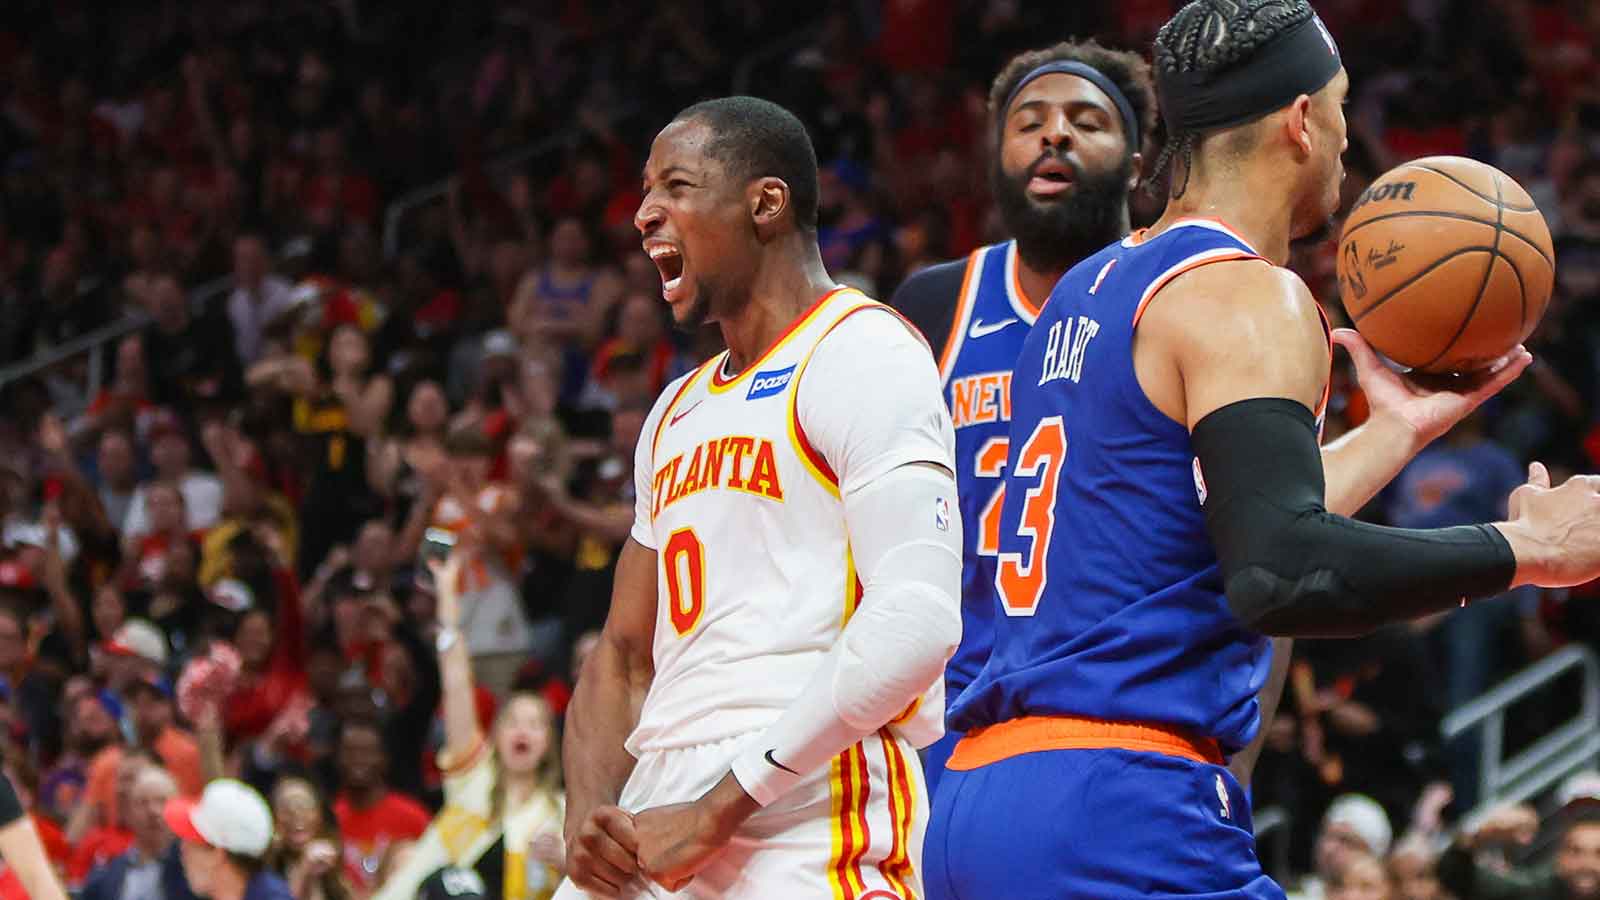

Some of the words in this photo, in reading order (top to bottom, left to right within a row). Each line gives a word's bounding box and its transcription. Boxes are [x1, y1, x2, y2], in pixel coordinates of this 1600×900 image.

[750, 371, 792, 395] paze
[1038, 315, 1100, 386] HART
[653, 435, 784, 520] TLANTA
[994, 415, 1067, 617] 3
[663, 526, 705, 638] 0
